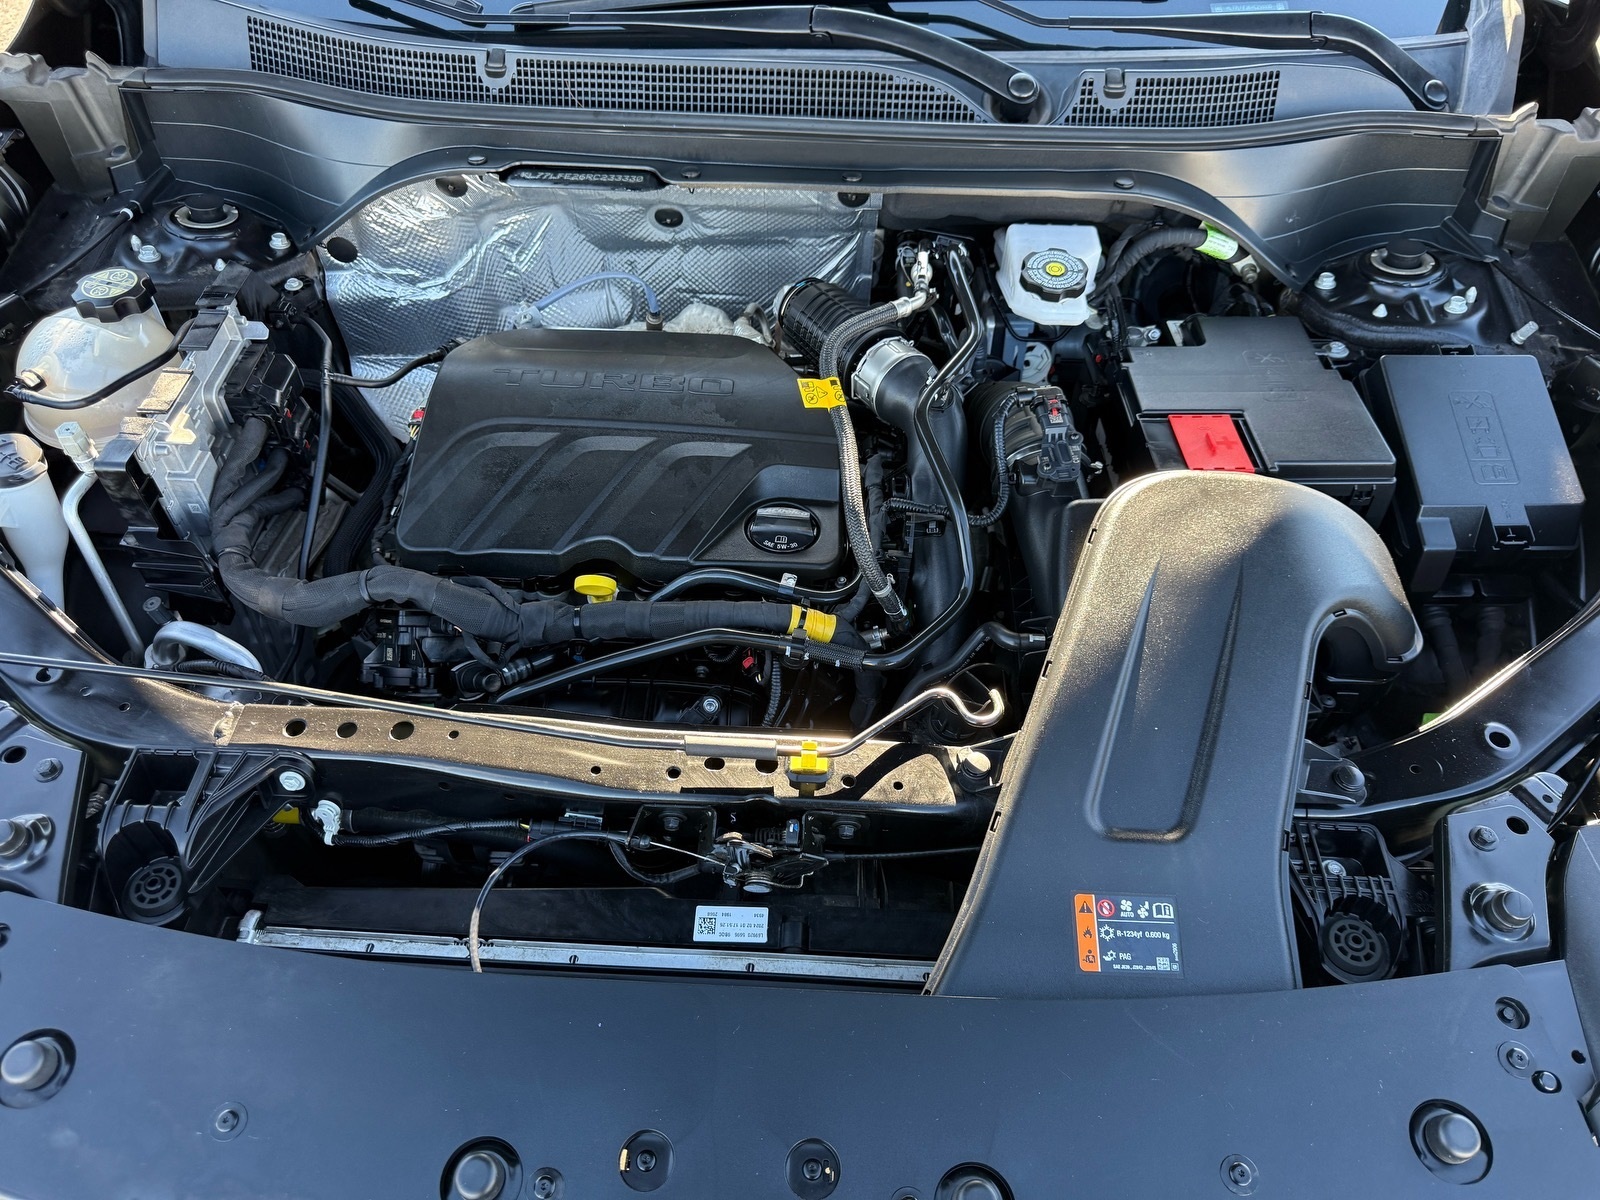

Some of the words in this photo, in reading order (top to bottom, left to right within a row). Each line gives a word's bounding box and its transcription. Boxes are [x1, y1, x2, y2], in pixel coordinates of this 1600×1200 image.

[493, 368, 735, 396] TURBO
[763, 540, 775, 548] SAE
[1116, 930, 1143, 939] R-1234yf
[1145, 931, 1161, 939] 0.600
[1162, 932, 1170, 940] kg
[1119, 952, 1132, 961] PAG
